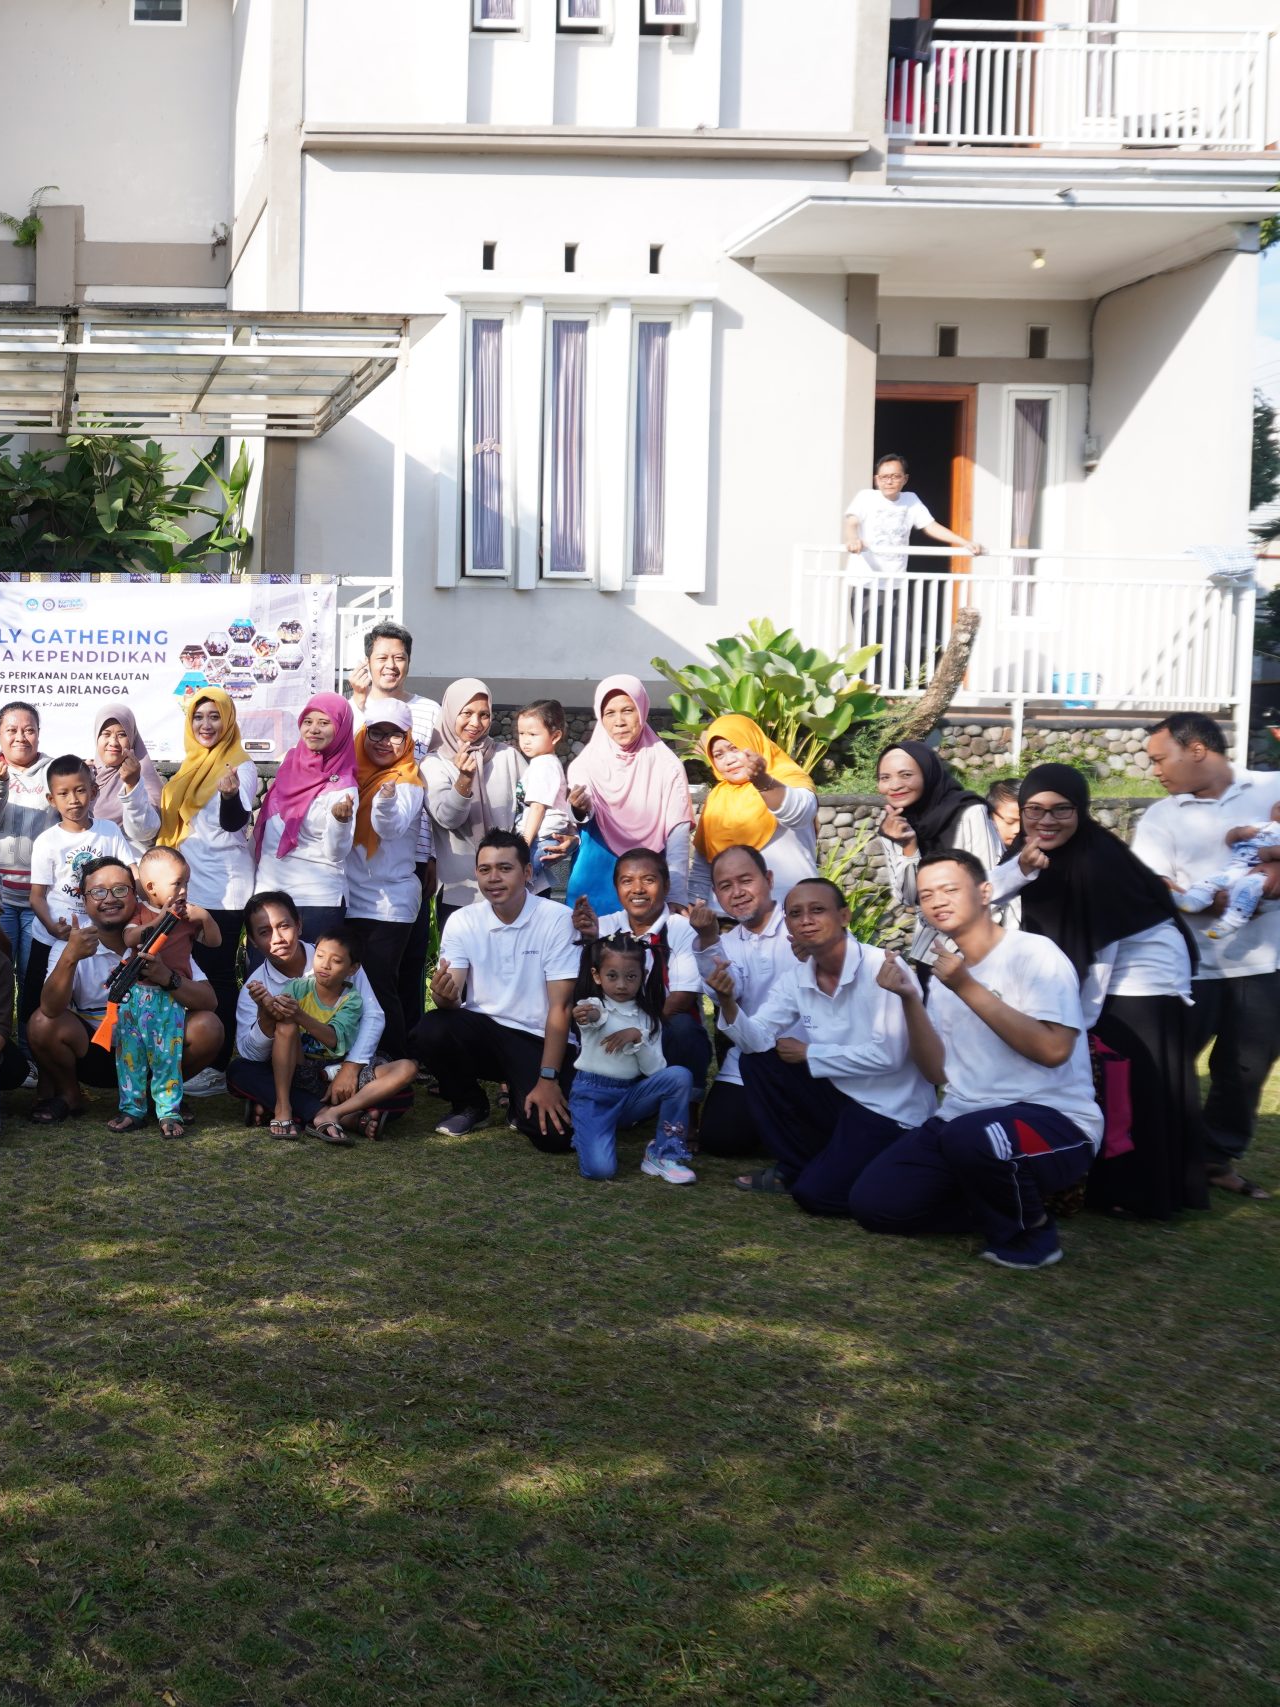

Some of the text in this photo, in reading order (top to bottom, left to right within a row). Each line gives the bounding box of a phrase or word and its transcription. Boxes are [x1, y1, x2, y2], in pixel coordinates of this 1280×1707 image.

[31, 628, 168, 646] GATHERING
[22, 650, 166, 664] KEPENDIDIKAN
[8, 672, 68, 680] PERIKANAN
[70, 672, 93, 680] DAN
[96, 672, 150, 681] KELAUTAN
[57, 685, 129, 695] AIRLANGGA
[65, 845, 103, 864] ASTRONAU
